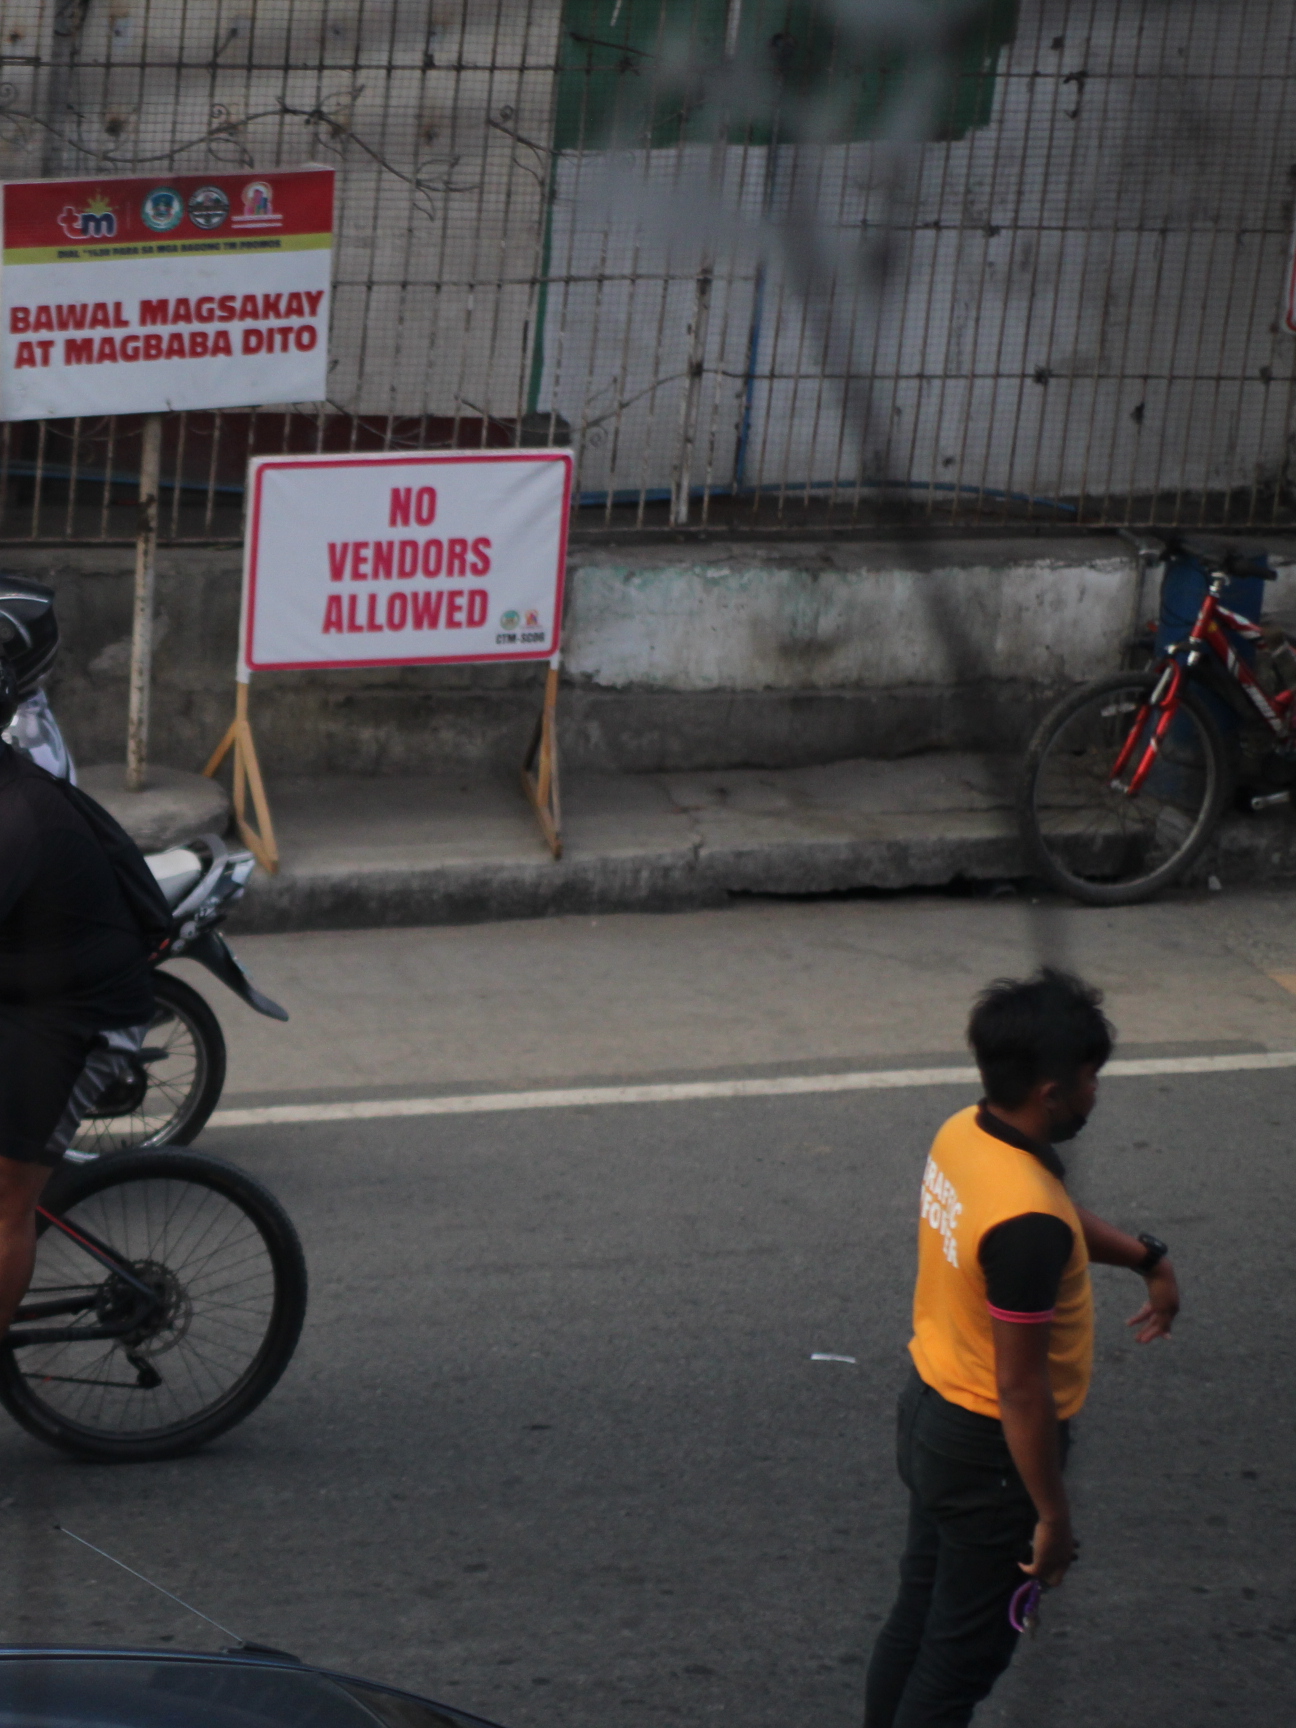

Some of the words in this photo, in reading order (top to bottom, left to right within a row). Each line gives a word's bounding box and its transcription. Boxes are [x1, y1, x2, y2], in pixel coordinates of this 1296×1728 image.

[10, 301, 130, 334] BAWAL
[139, 290, 324, 327] MAGSAKAY
[14, 340, 55, 369] AT
[64, 330, 233, 366] MAGBABA
[242, 324, 317, 355] DITO
[389, 486, 437, 528] NO
[327, 536, 492, 582] VENDORS
[321, 589, 489, 634] ALLOWED
